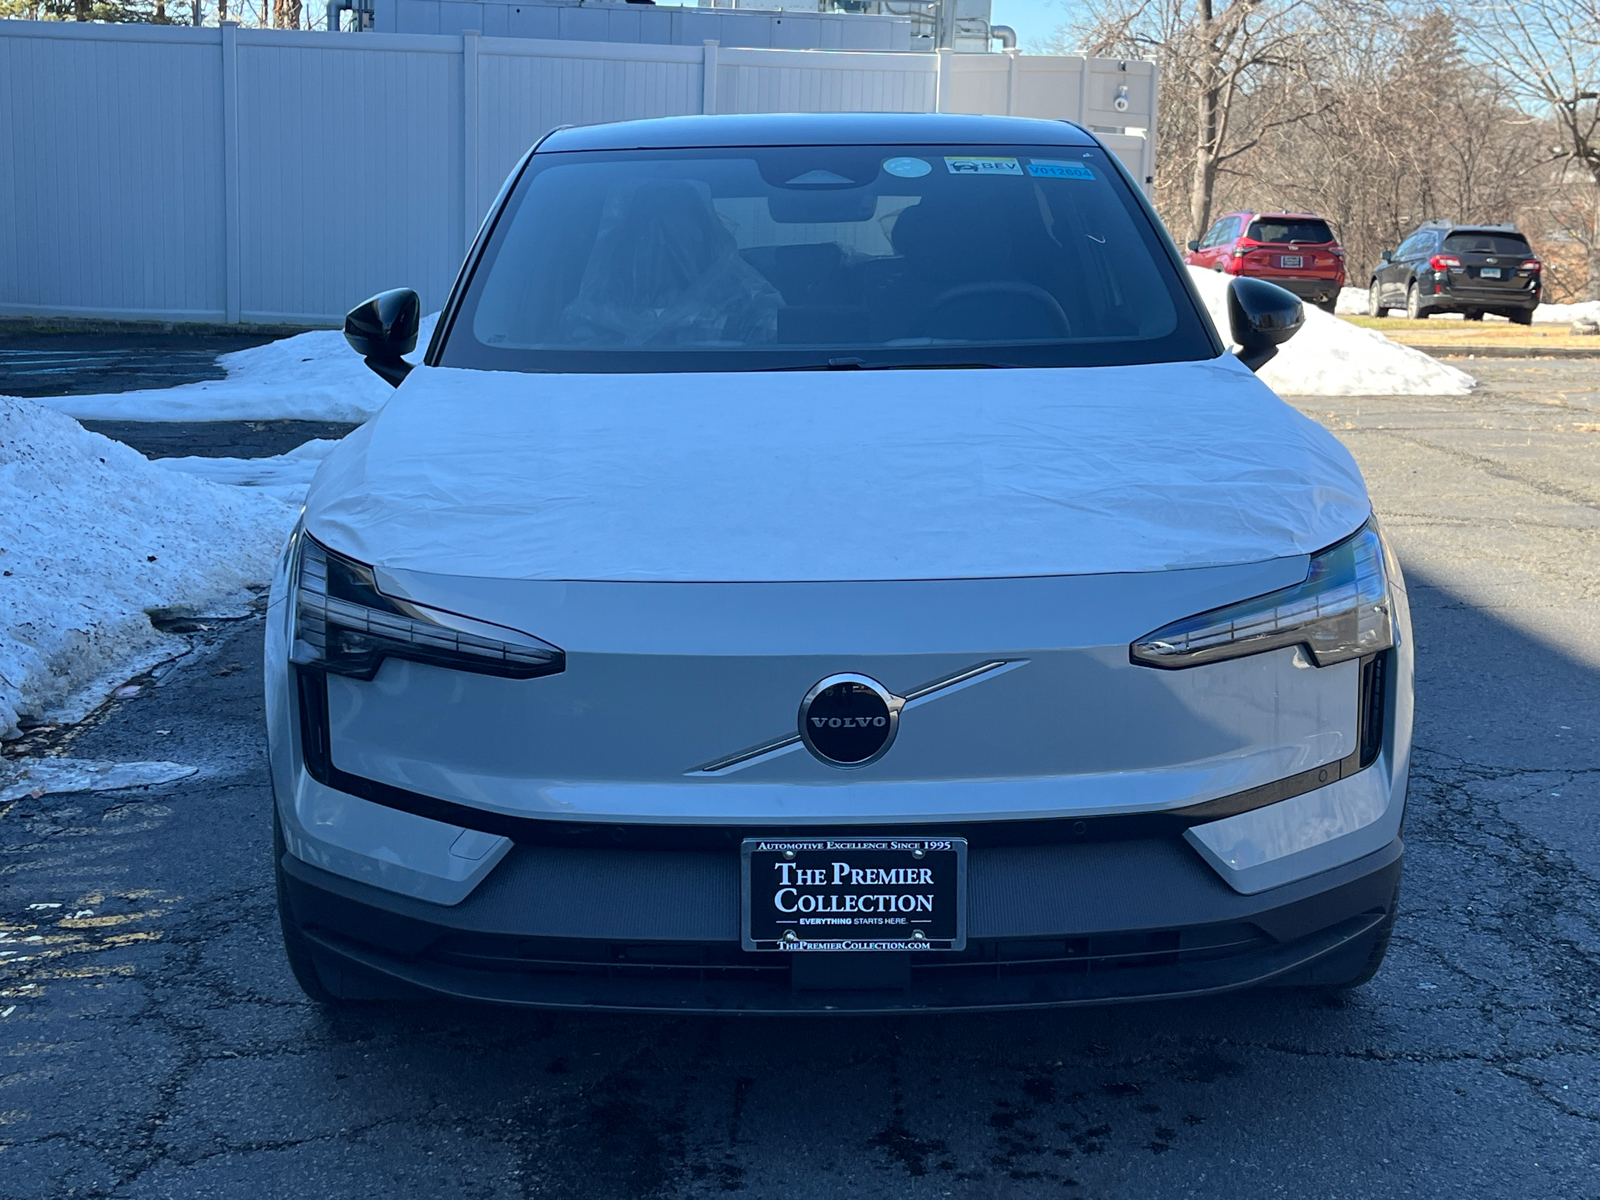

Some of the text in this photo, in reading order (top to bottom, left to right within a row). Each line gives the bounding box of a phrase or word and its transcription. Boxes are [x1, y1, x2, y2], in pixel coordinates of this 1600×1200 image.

[982, 162, 1017, 170] BEV
[811, 716, 887, 728] VOLVO
[757, 841, 951, 850] AUTOMOTIVE EXCELLENCE SINCE 1995
[774, 862, 934, 885] THE PREMIER
[774, 887, 934, 913] COLLECTION
[799, 917, 852, 925] EVERYTHING
[853, 917, 883, 925] STARTS
[776, 940, 931, 950] THEPREMIERCOLLECTION.COM
